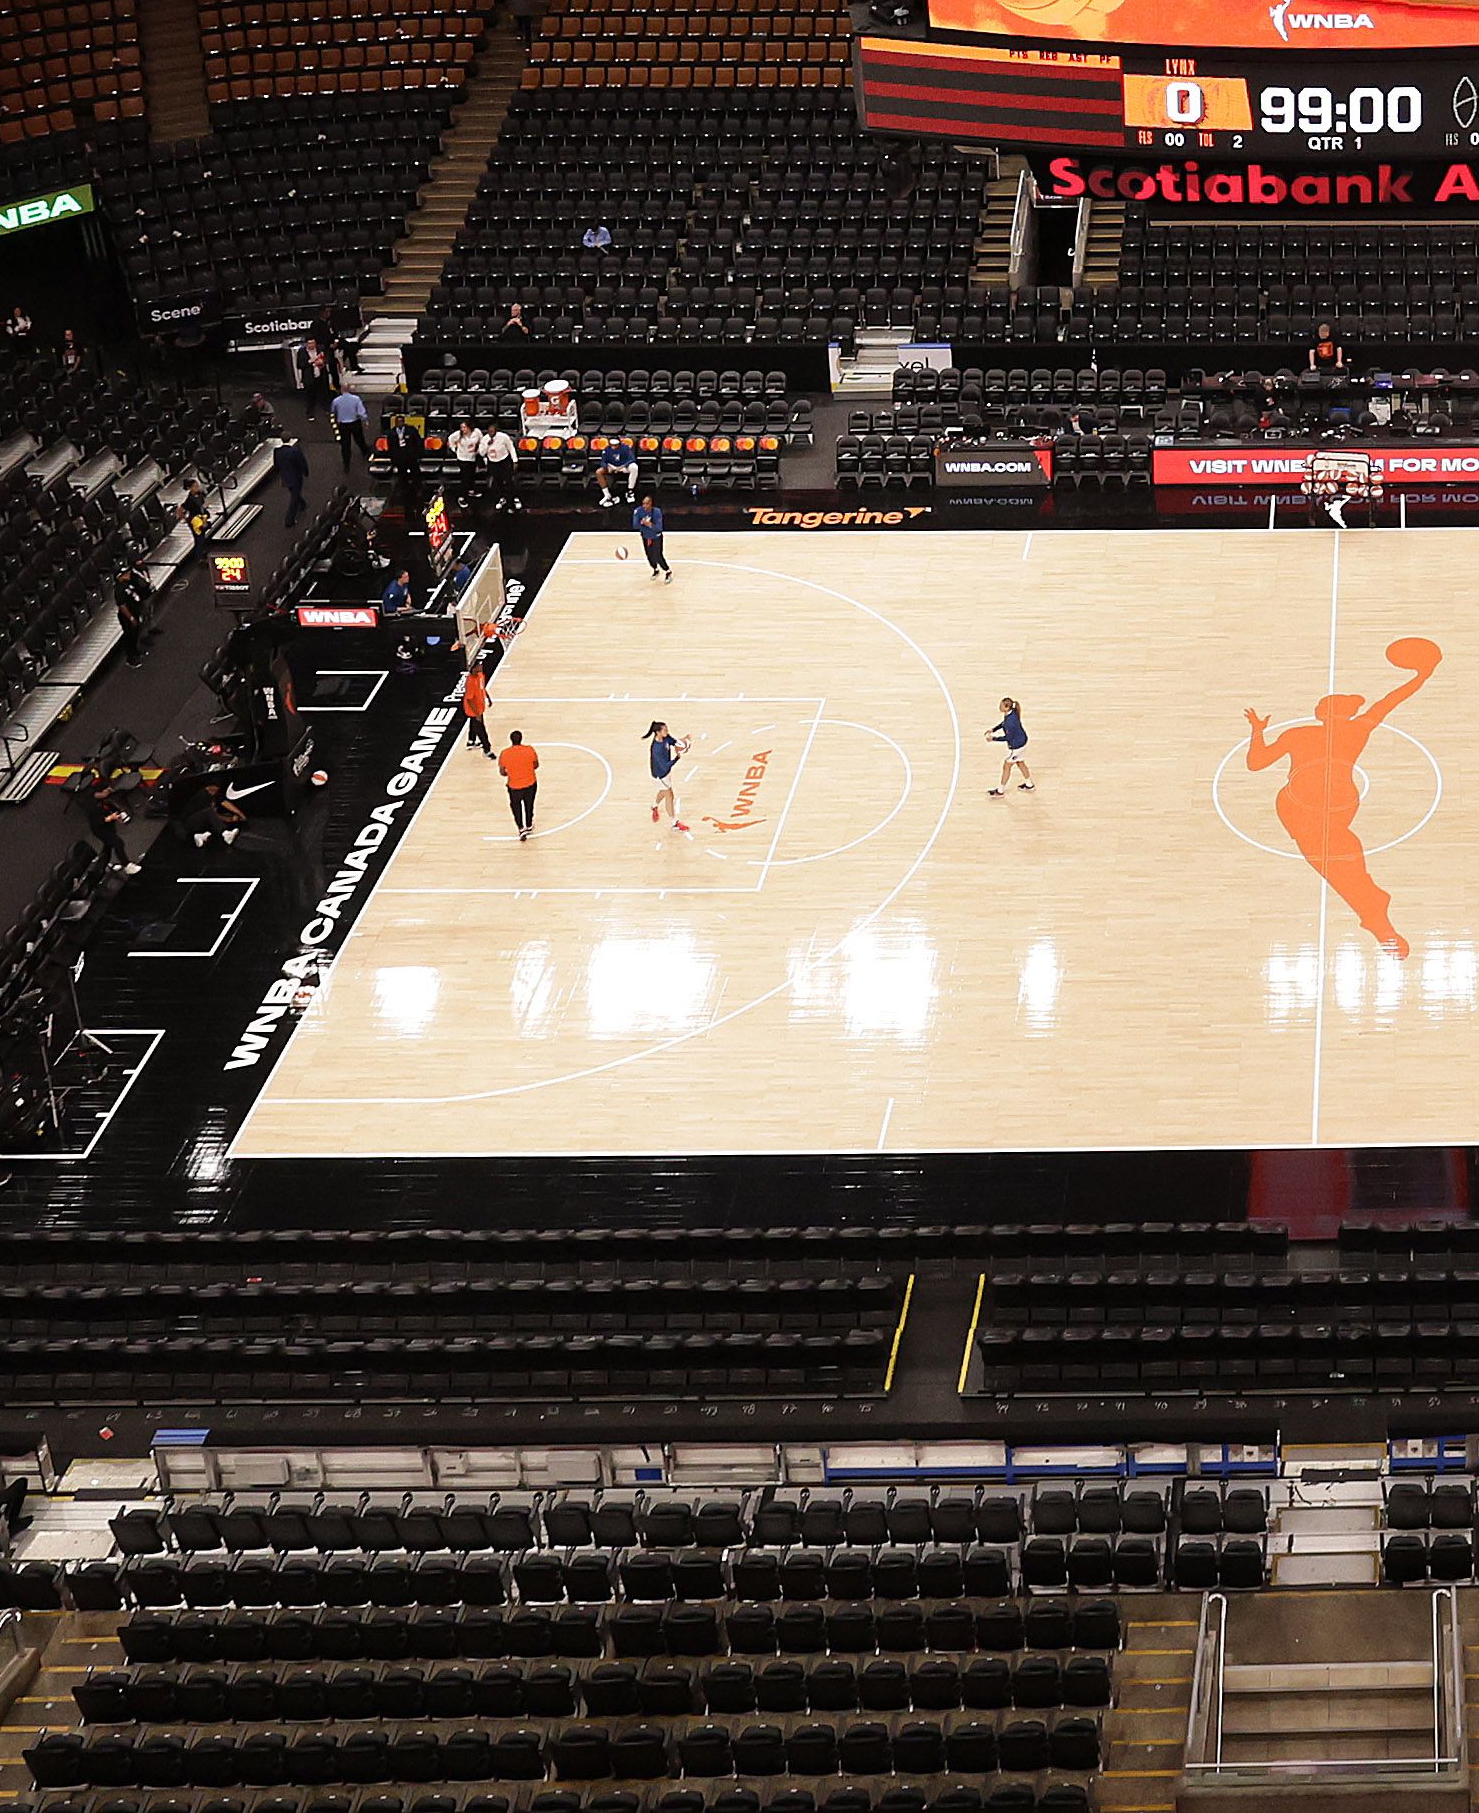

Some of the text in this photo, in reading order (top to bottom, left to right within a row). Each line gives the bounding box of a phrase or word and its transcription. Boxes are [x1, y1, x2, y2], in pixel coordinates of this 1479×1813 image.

[1288, 9, 1374, 30] WNBA
[1009, 49, 1113, 64] PTS REB AST PF
[1165, 58, 1196, 75] LYNX
[1165, 81, 1204, 123] 0
[1260, 87, 1422, 135] 99:00
[1137, 131, 1243, 149] FLS 00 TOL 2
[1308, 136, 1363, 151] QTR 1
[1048, 156, 1413, 204] Scotiabank
[151, 304, 200, 322] Scene
[944, 461, 1032, 474] WNBA.COM
[1189, 459, 1247, 474] VISIT
[1389, 458, 1437, 472] FOR
[748, 507, 904, 529] Tangerine
[221, 568, 241, 581] 24
[303, 609, 370, 625] WNBA
[730, 748, 773, 820] WNBA
[224, 706, 458, 1071] WNBA CANADA GAME
